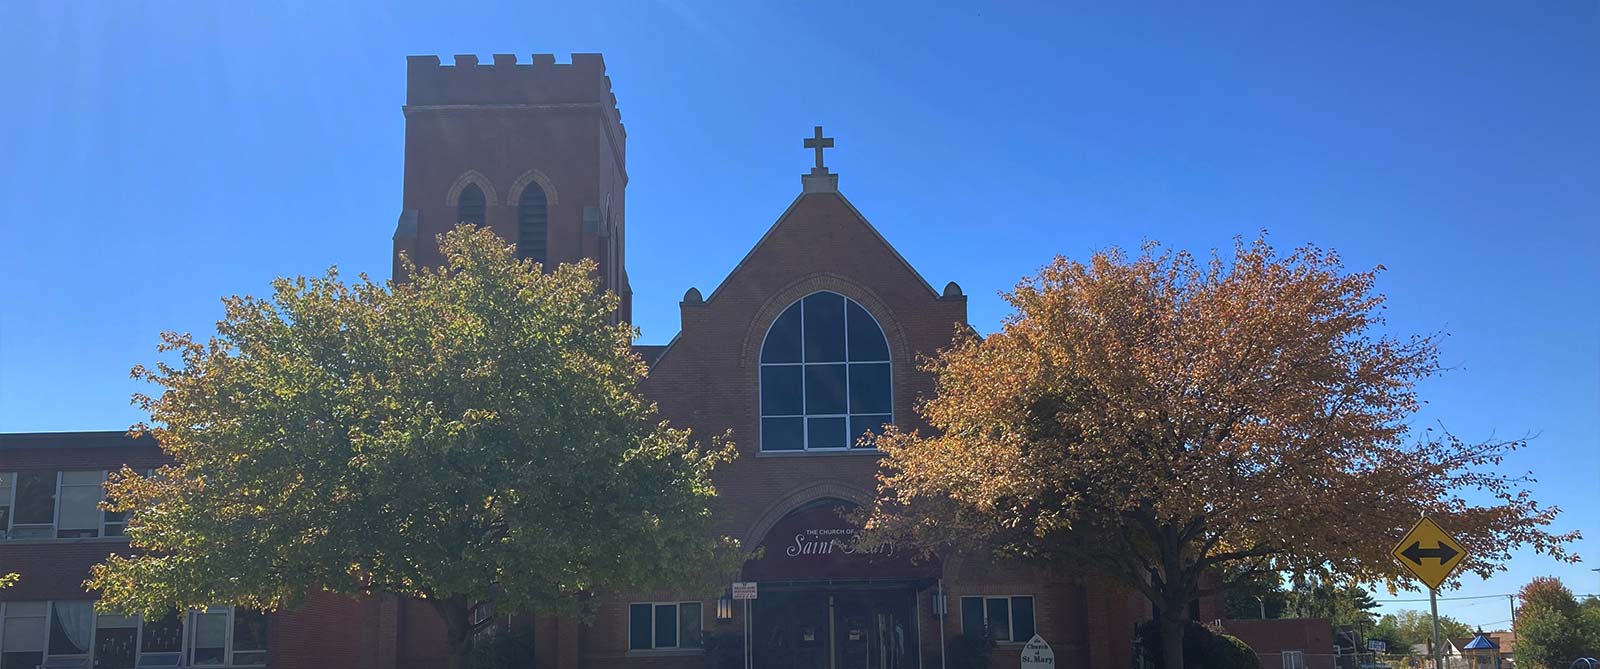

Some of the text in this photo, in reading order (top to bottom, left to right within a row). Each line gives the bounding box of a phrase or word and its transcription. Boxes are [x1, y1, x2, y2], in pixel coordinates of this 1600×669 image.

[786, 534, 834, 556] Saint
[1022, 655, 1052, 664] St. Mary
